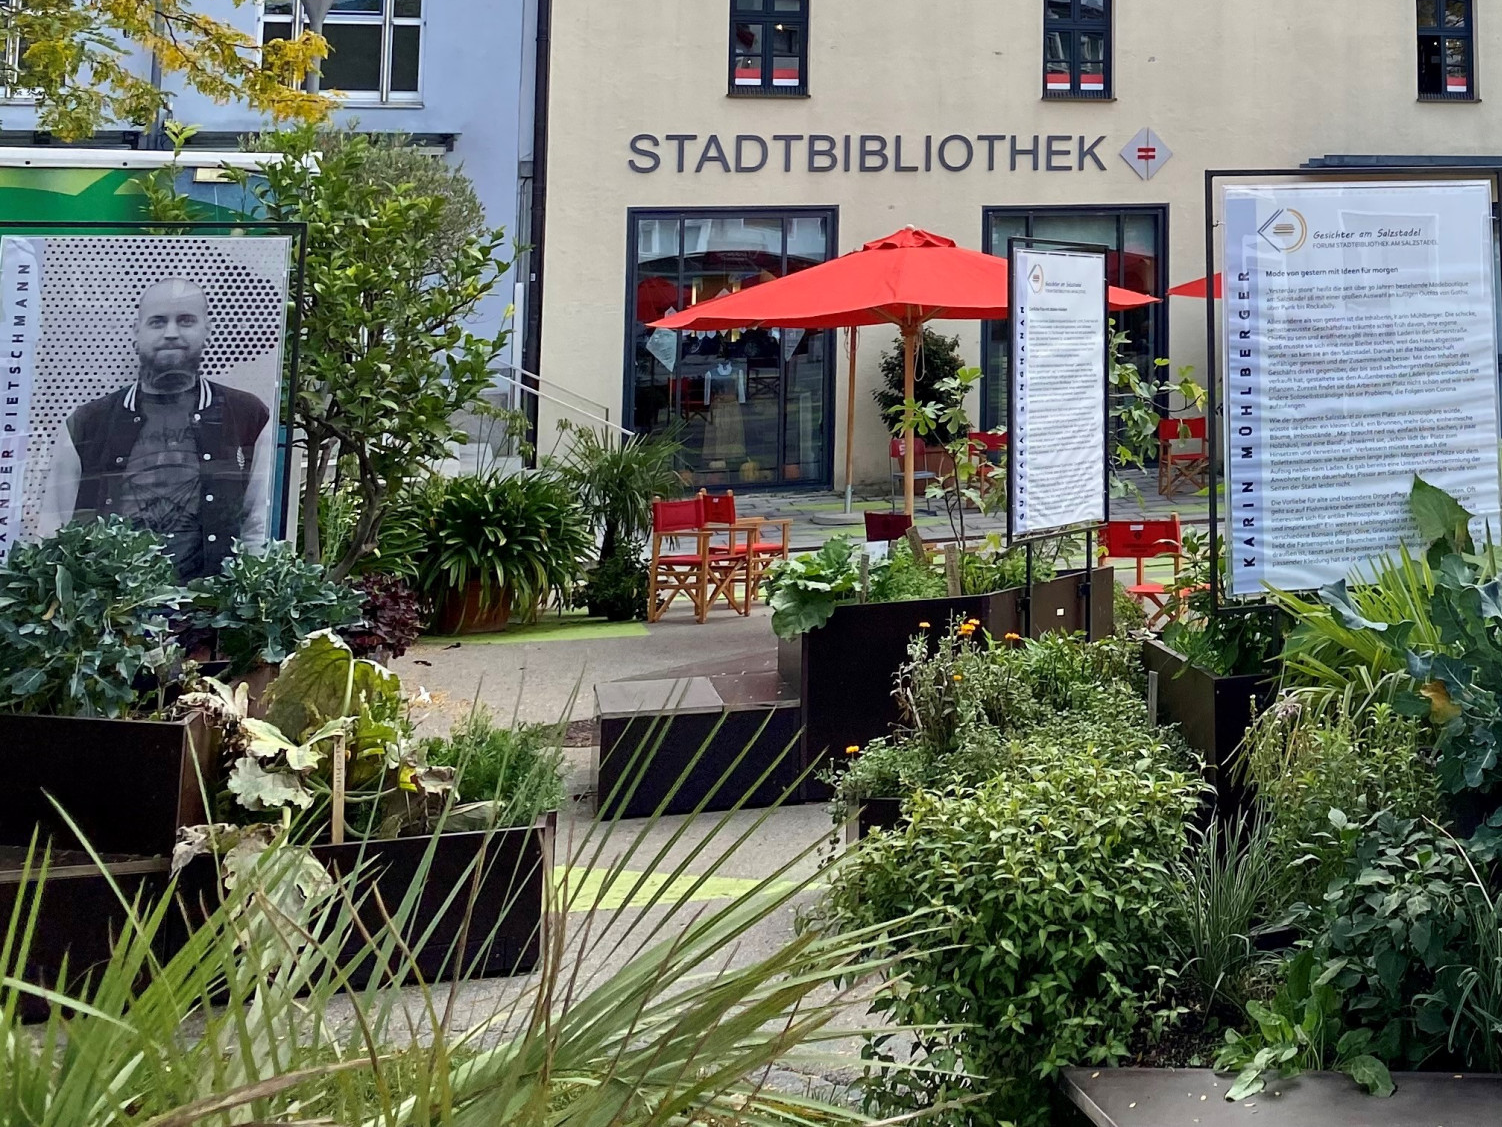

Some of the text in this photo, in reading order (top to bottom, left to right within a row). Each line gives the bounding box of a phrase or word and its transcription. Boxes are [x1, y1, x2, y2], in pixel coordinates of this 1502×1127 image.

[628, 134, 1107, 173] STADTBIBLIOTHEK
[1313, 229, 1355, 239] Gesichter
[1376, 228, 1421, 238] Salzstadel
[1300, 268, 1326, 278] gestern
[4, 264, 30, 432] PIETSCHMANN
[1242, 480, 1256, 568] KARIN
